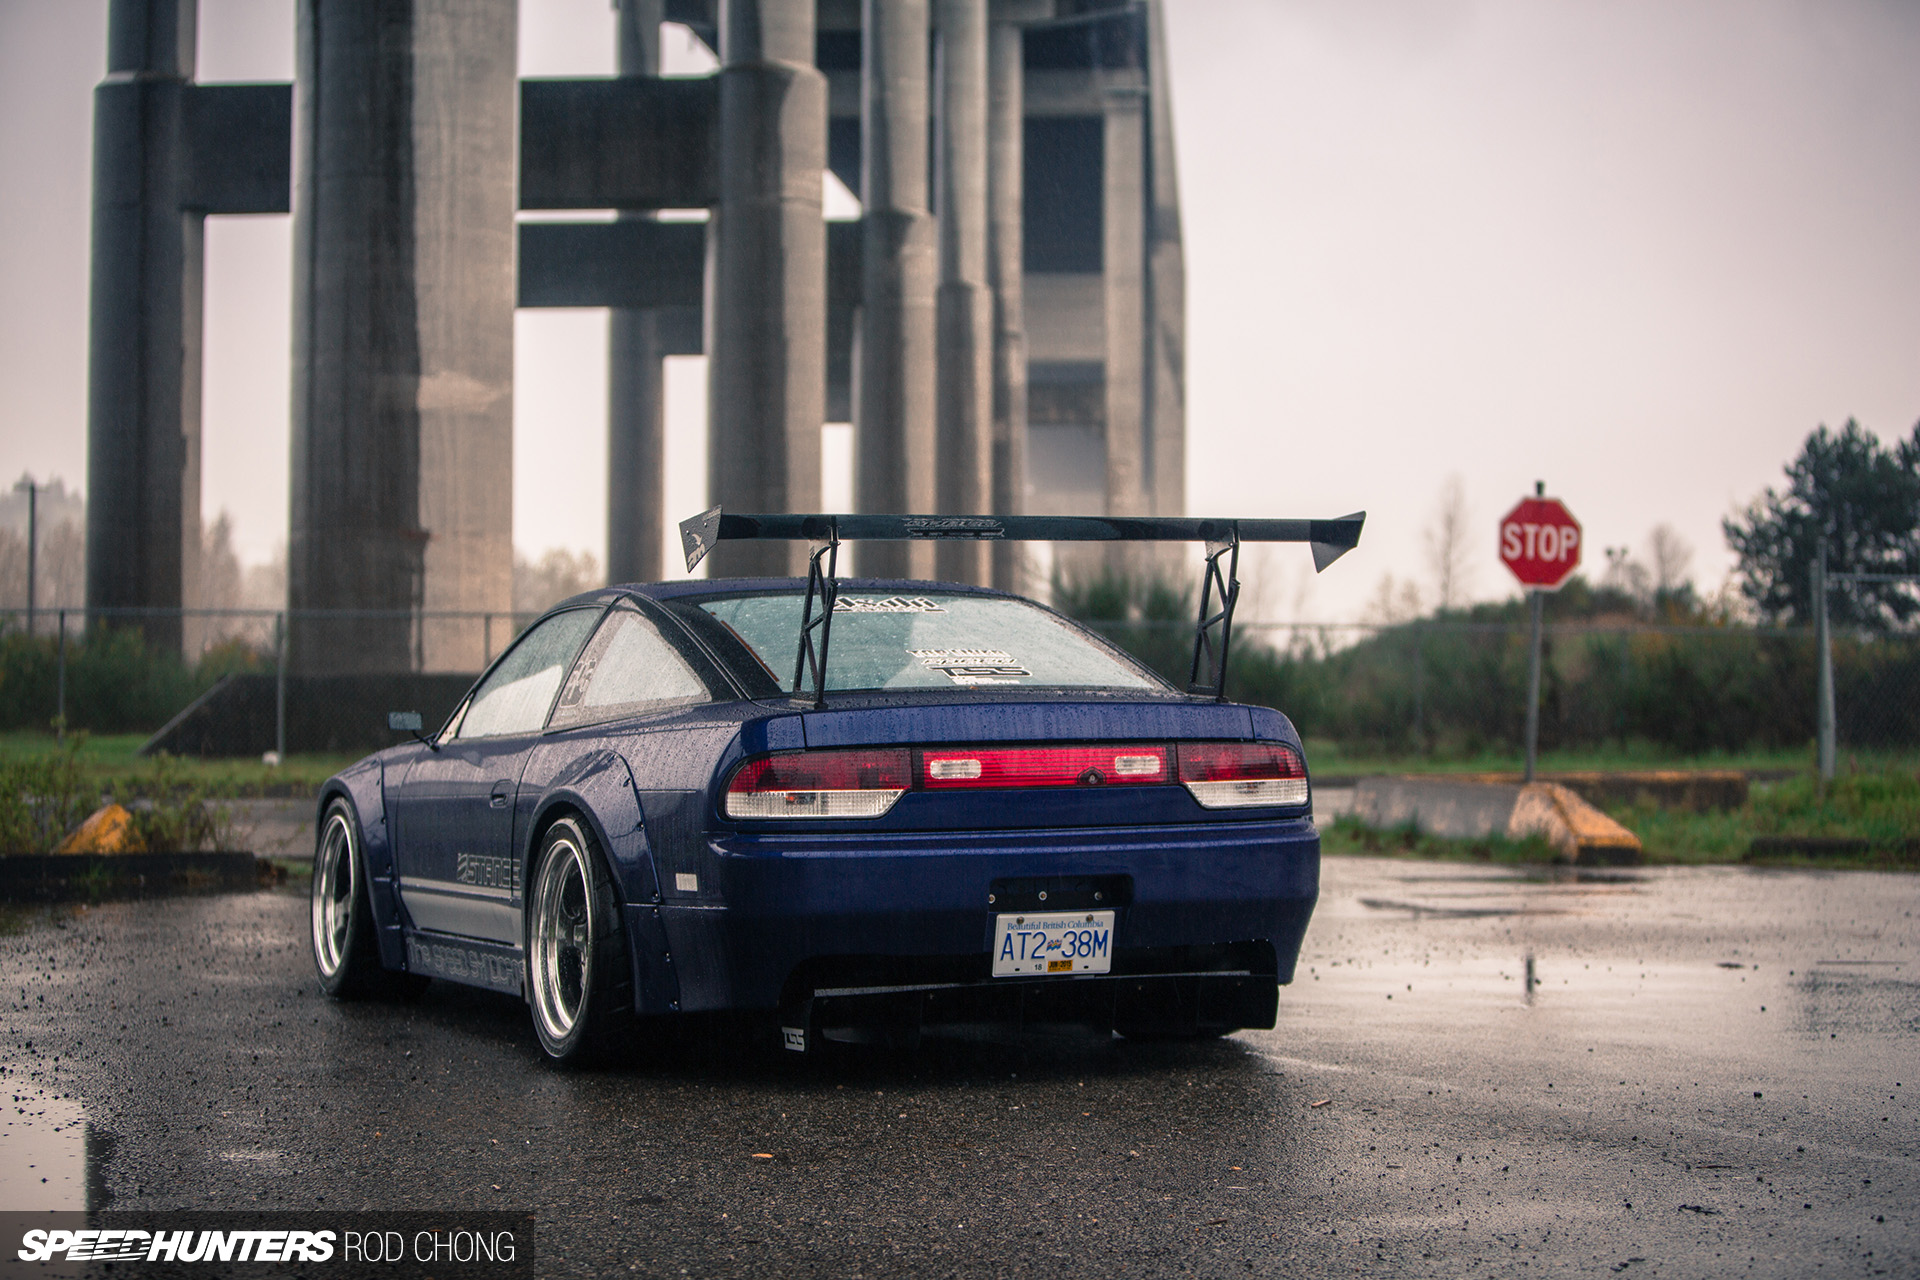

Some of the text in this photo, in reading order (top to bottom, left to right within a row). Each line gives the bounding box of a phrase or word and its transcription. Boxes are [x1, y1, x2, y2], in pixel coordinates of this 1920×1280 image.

[1503, 522, 1578, 562] STOP
[467, 854, 521, 889] STANCE
[1007, 921, 1104, 931] Beautiful British Columbia
[1000, 929, 1109, 960] AT2 38M
